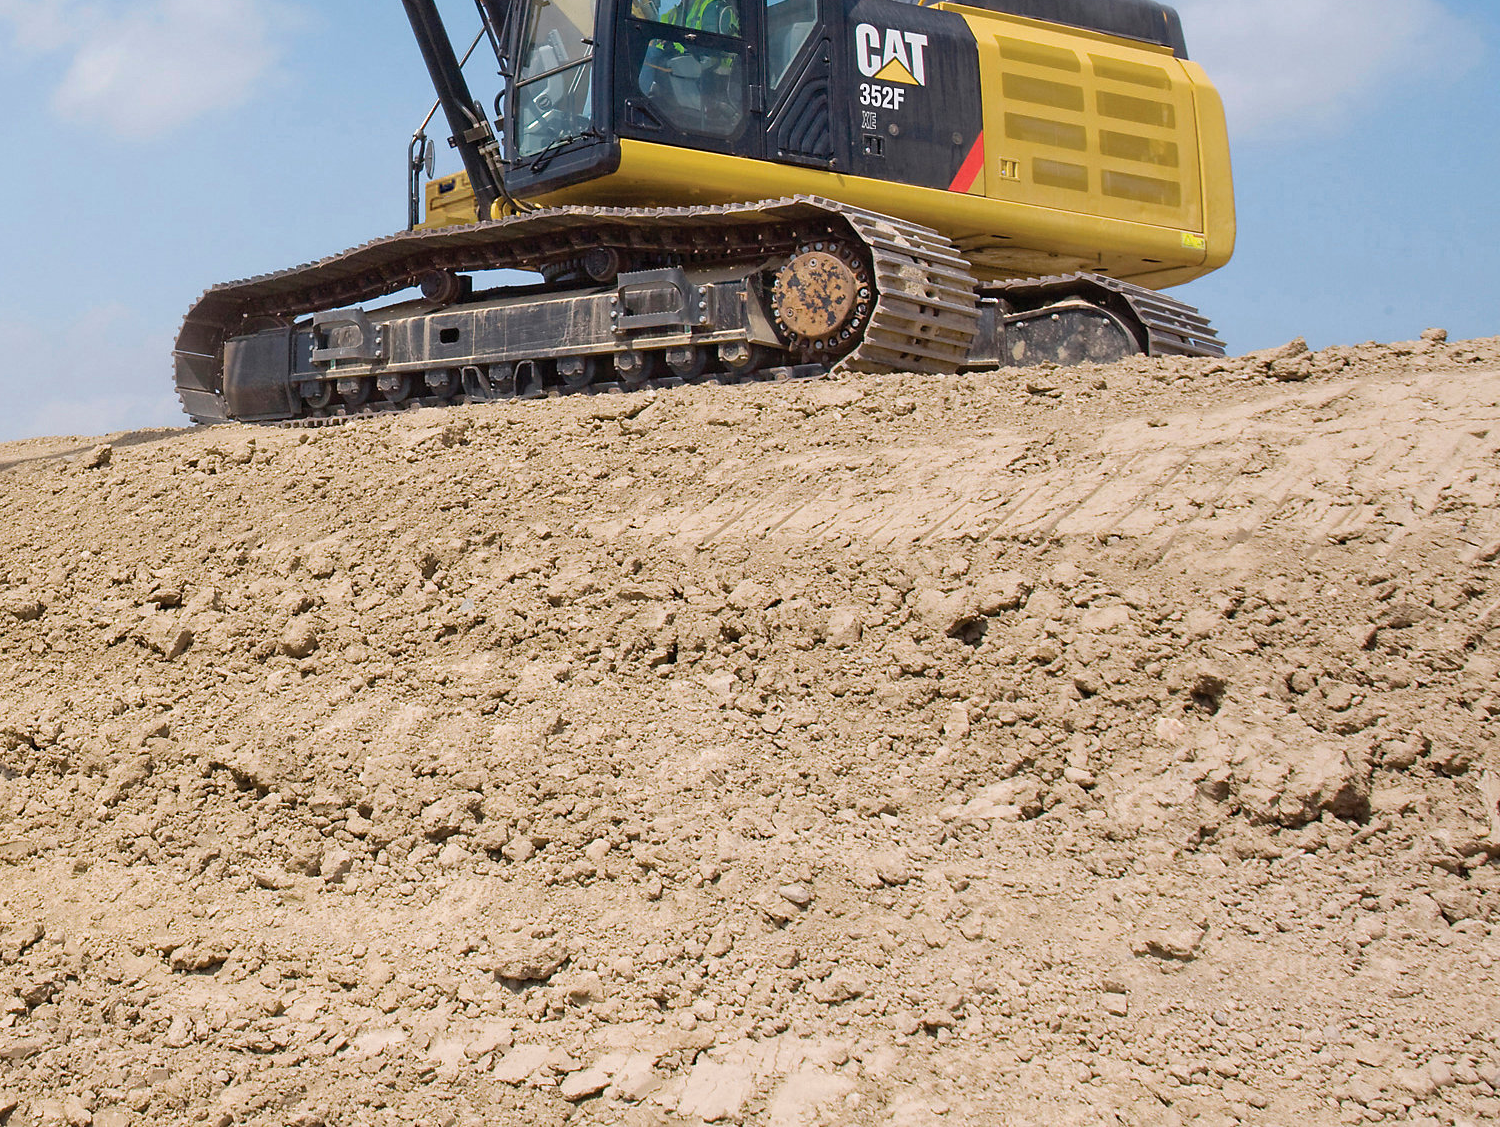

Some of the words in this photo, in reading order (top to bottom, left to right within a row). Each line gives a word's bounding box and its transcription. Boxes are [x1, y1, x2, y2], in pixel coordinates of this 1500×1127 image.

[855, 23, 928, 86] CAT
[860, 83, 905, 110] 352F
[861, 110, 877, 130] XE
